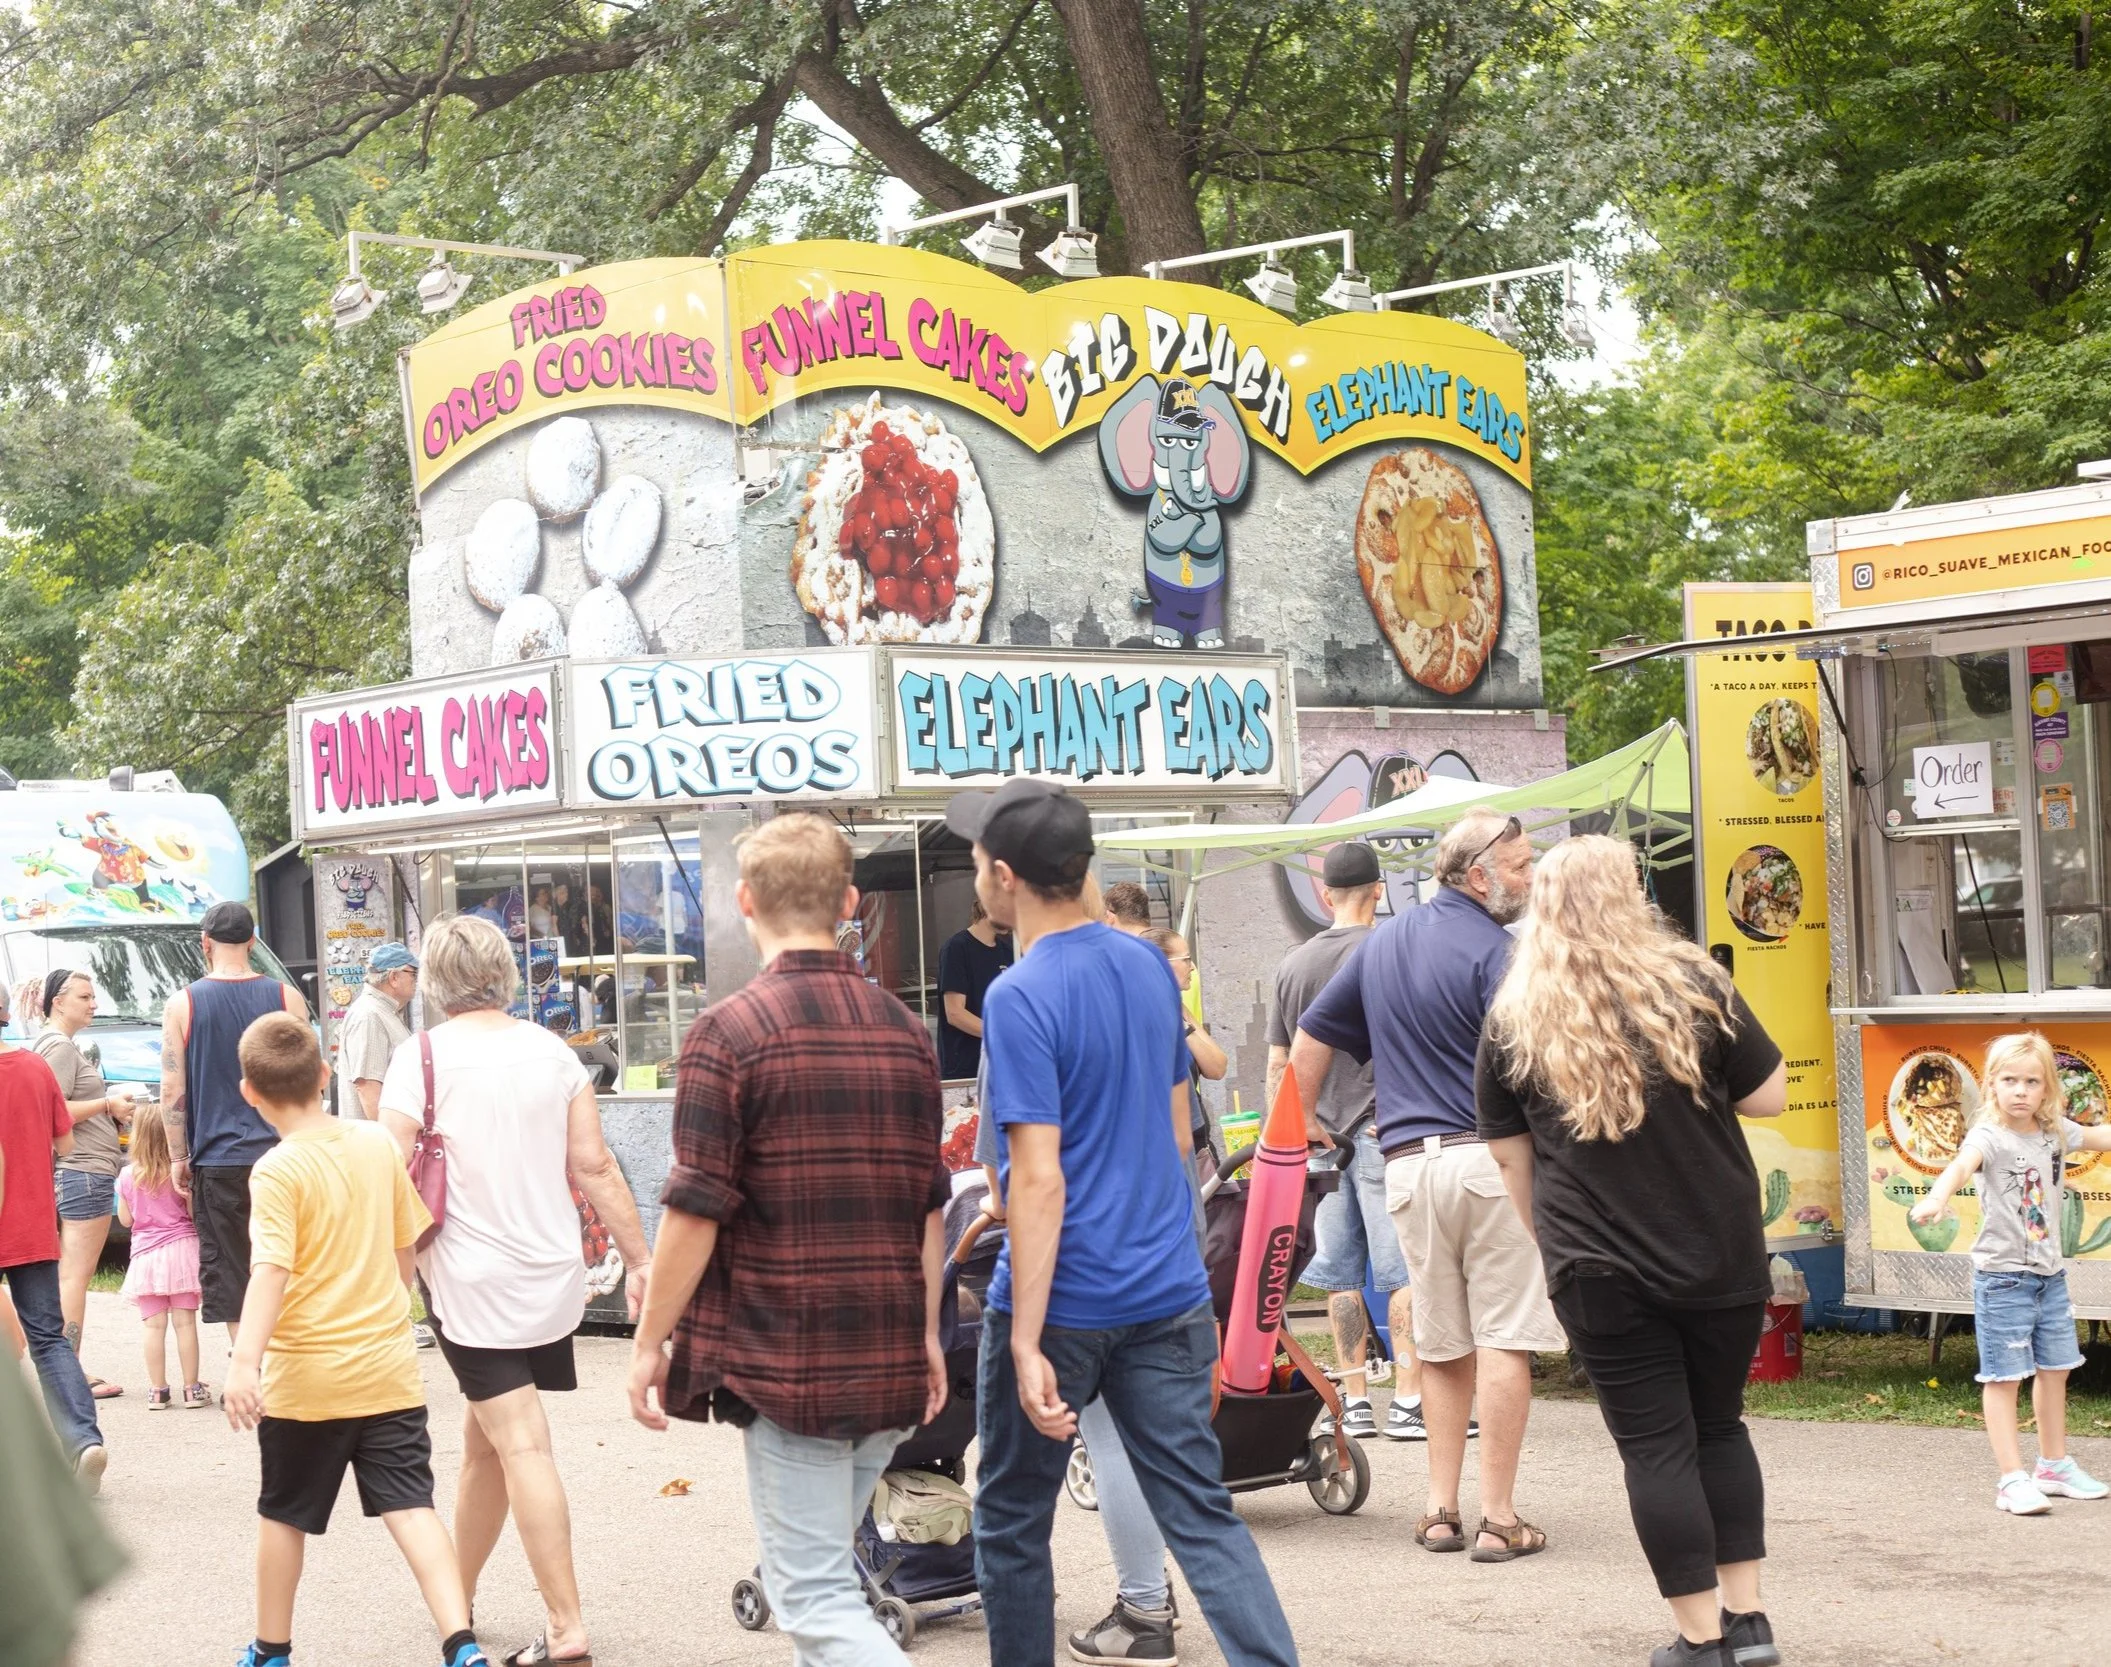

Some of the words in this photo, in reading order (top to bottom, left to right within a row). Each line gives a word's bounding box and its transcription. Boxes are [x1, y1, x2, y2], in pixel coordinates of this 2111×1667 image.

[510, 283, 608, 349] FRIED
[742, 289, 902, 396] FUNNEL
[907, 297, 1035, 415] CAKES
[1040, 311, 1137, 430] BIG
[1143, 306, 1292, 439] DOUGH
[422, 359, 525, 460] OREO
[535, 332, 719, 397] COOKIES
[1172, 388, 1200, 411] XXL
[1304, 360, 1451, 445] ELEPHANT
[1456, 374, 1527, 465] EARS
[1148, 514, 1164, 532] XXL
[600, 659, 841, 731] FRIED
[1782, 682, 1809, 690] KEEPS
[897, 668, 1150, 783] ELEPHANT
[1162, 672, 1275, 783] EARS
[310, 704, 438, 814] FUNNEL
[441, 686, 549, 802] CAKES
[587, 728, 860, 801] OREOS
[1389, 765, 1428, 799] XXL
[1921, 752, 1983, 788] Order
[1775, 815, 1813, 824] BLESSED
[329, 865, 347, 886] BIG
[349, 863, 379, 884] DOUGH
[1805, 922, 1825, 930] HAVE
[529, 954, 554, 966] OREO
[544, 1005, 571, 1018] OREO
[1901, 1045, 1928, 1063] BURRITO
[1929, 1045, 1951, 1054] CHULO
[1956, 1053, 1980, 1080] BURRITO
[2076, 1050, 2097, 1069] FIESTA
[1806, 1102, 1816, 1110] ES
[1818, 1101, 1829, 1109] LA
[1885, 1123, 1903, 1154] BURRITO
[1906, 1157, 1927, 1173] CHULO
[2066, 1165, 2089, 1178] FIESTA
[1261, 1233, 1292, 1326] CRAYON
